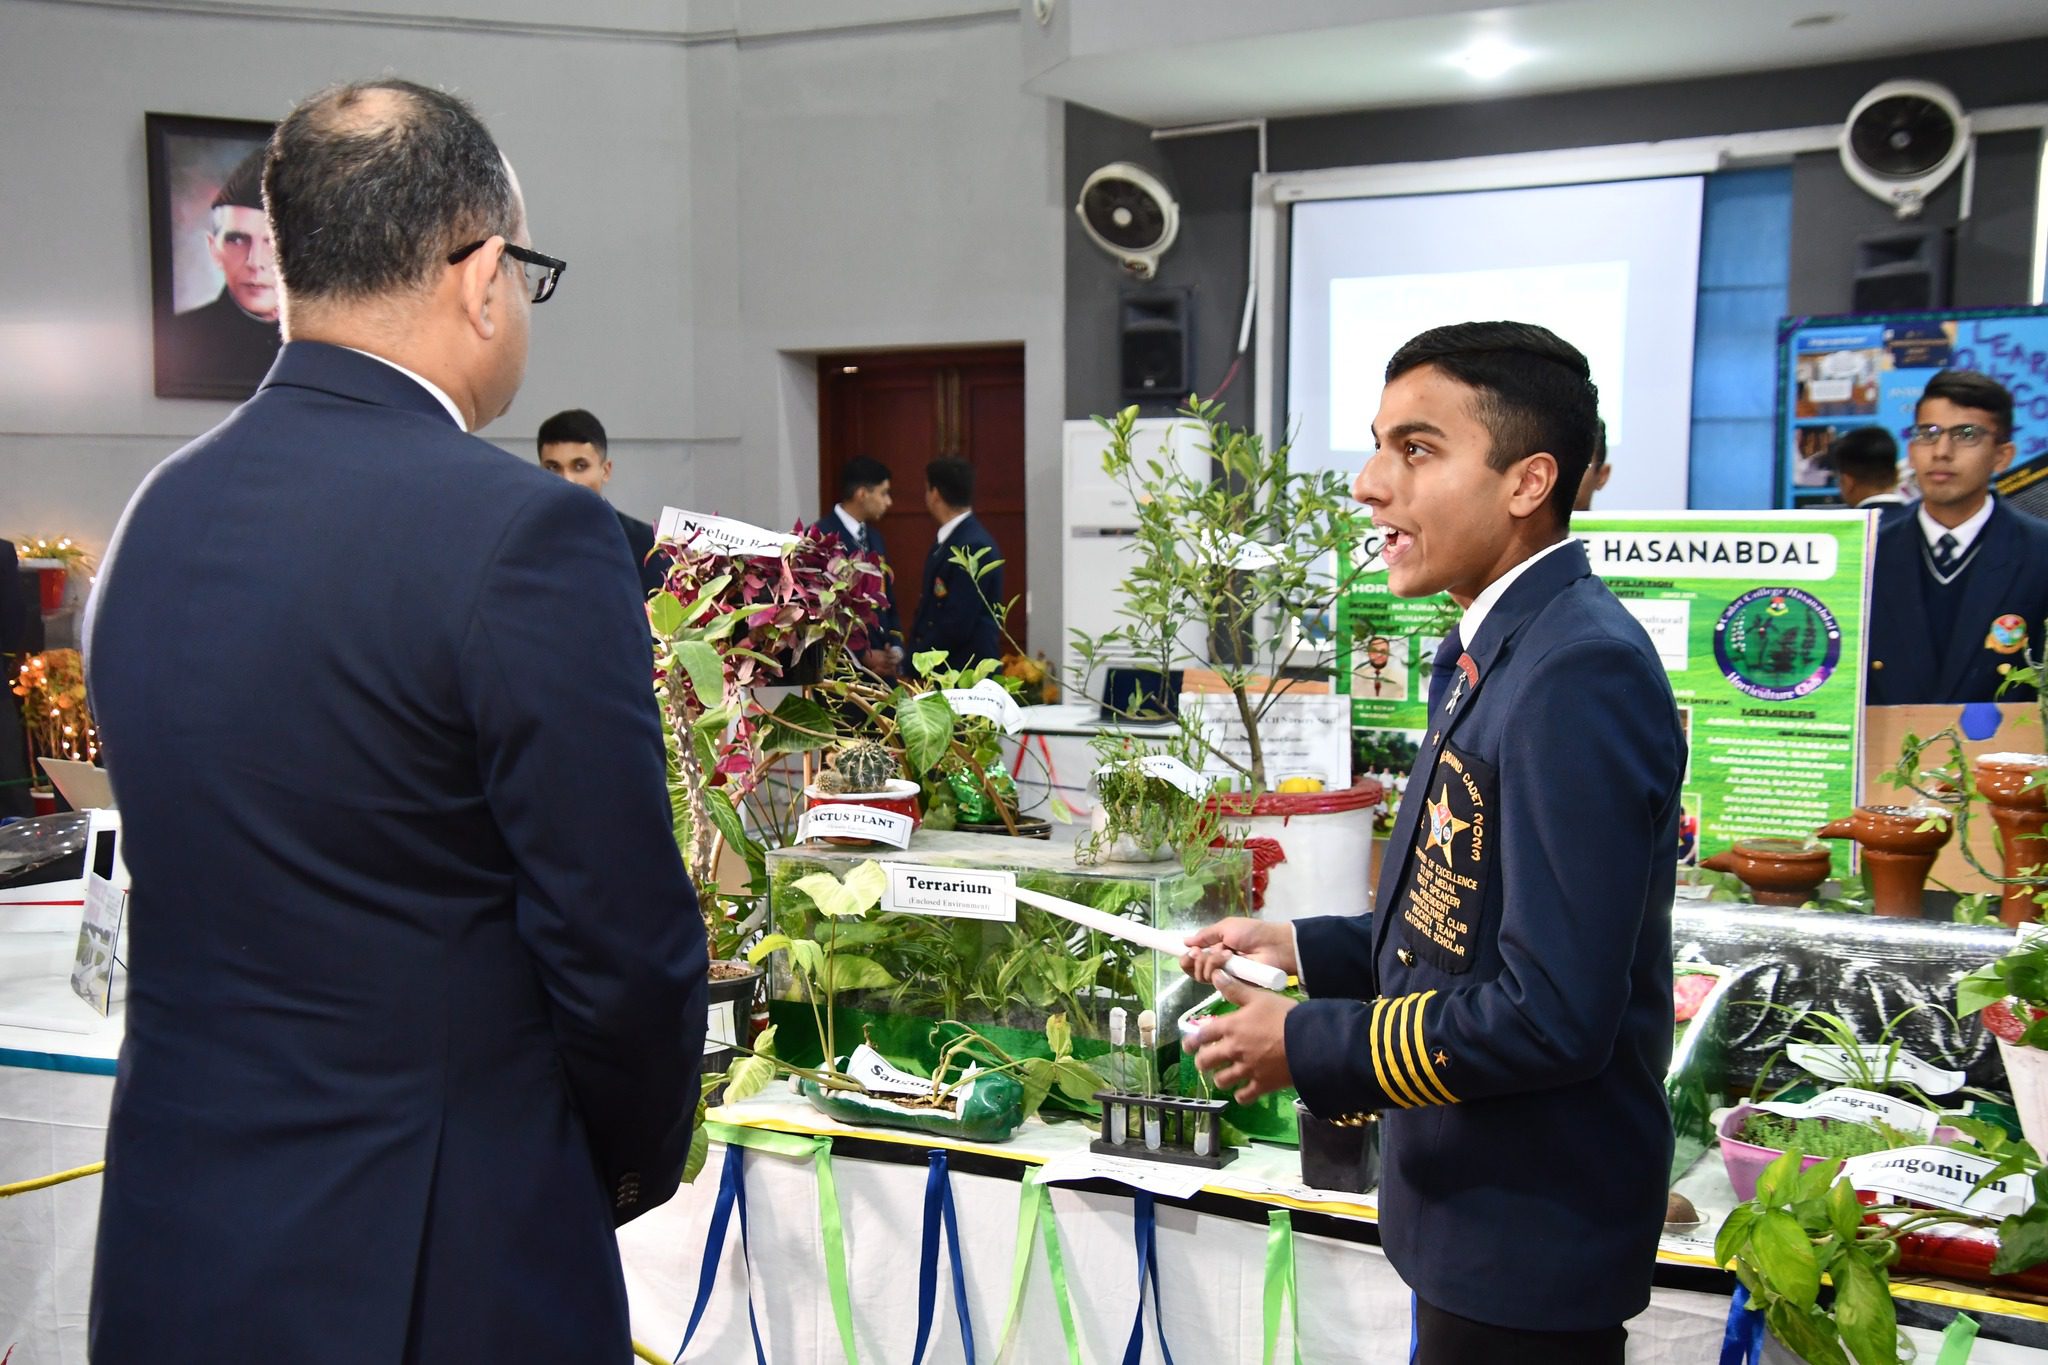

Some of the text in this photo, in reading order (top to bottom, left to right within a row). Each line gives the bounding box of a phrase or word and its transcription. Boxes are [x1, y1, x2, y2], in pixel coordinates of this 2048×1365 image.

[1604, 540, 1820, 565] HASANABDAL
[1741, 708, 1817, 719] MEMBERS
[1462, 772, 1483, 807] CADET
[809, 812, 850, 824] ACTUS
[853, 813, 895, 830] PLANT
[1471, 812, 1484, 861] 2023
[906, 876, 992, 895] Terrarium
[1417, 873, 1461, 909] BEST SPEAKER
[1420, 863, 1456, 895] STAFF MEDAL
[1436, 864, 1479, 891] EXCELLENCE
[908, 897, 941, 907] (Enclosed
[1409, 888, 1468, 935] HORTICULTURE CLUB
[1419, 887, 1451, 915] PRESIDENT
[1404, 909, 1466, 957] CATCHPOLE SCHOLAR
[1412, 904, 1457, 941] HOCKEY TEAM
